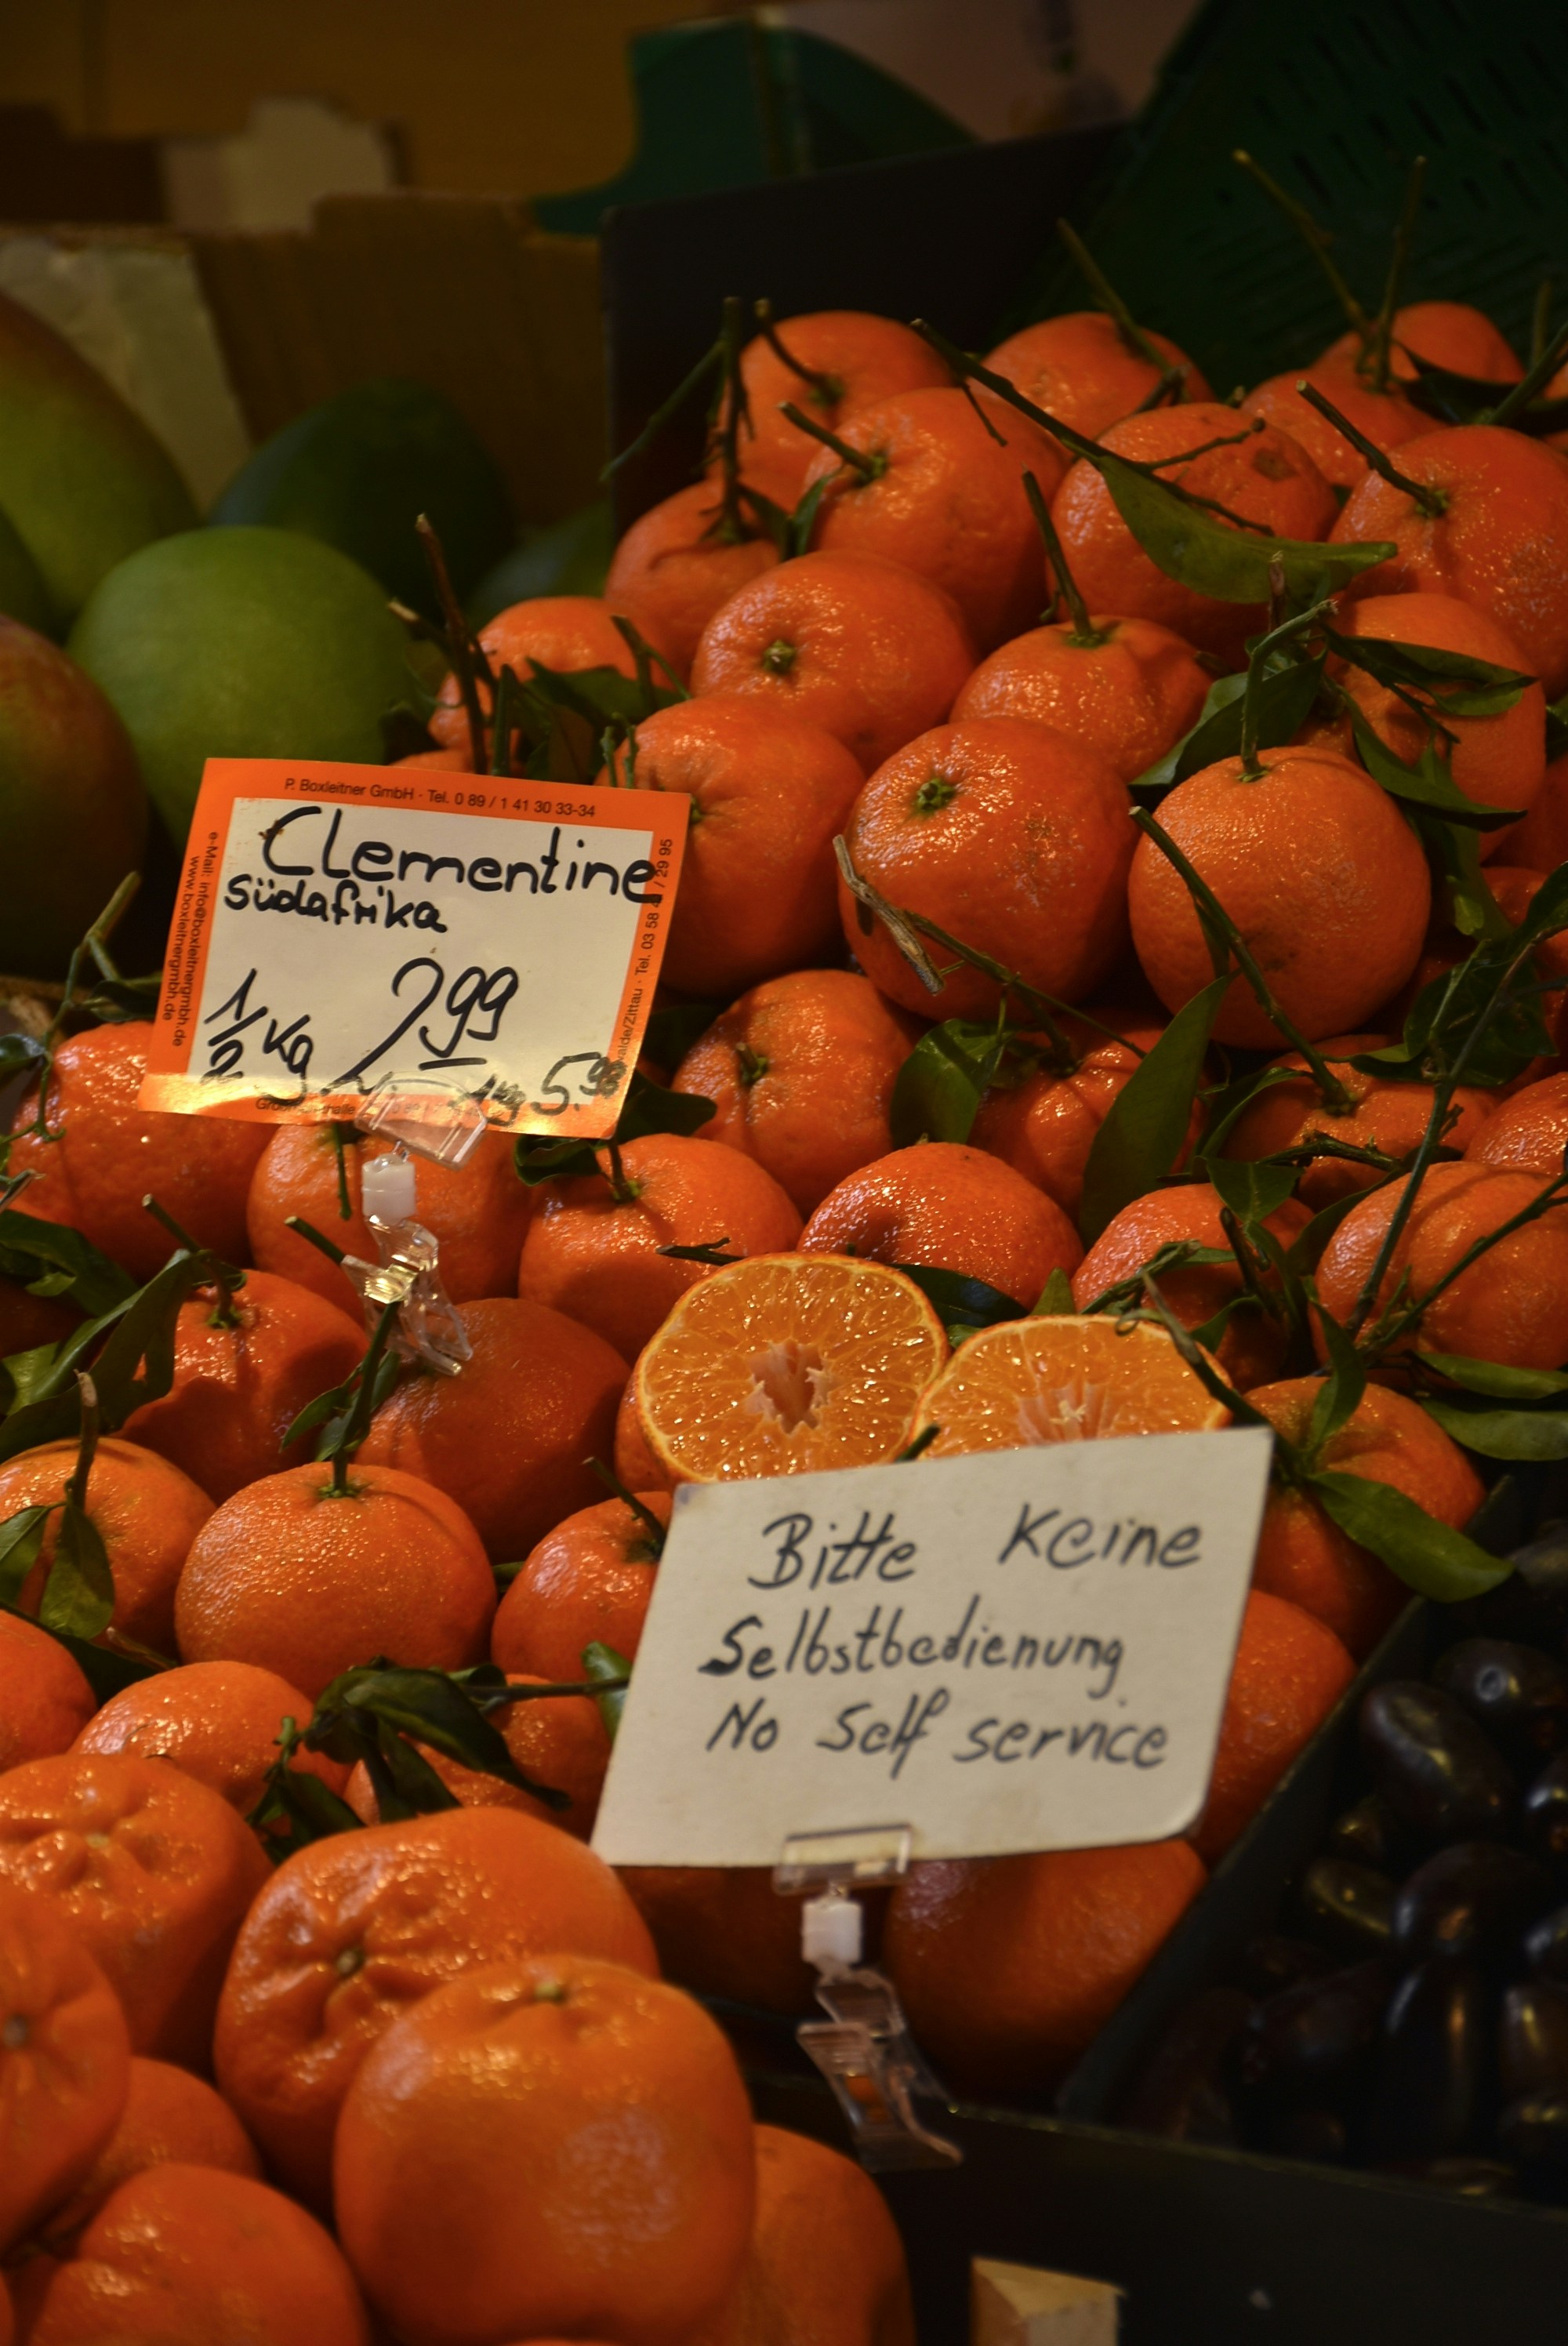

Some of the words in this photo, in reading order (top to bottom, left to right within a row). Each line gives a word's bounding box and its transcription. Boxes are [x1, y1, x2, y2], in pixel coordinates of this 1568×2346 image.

[285, 778, 296, 790] P.
[299, 779, 366, 796] Boxleitner
[370, 784, 414, 800] GmbH
[428, 789, 449, 804] Tel.
[454, 793, 464, 805] 0
[467, 794, 485, 808] 89
[500, 797, 508, 810] 1
[513, 798, 529, 812] 41
[534, 800, 551, 814] 30
[555, 801, 596, 817] 33-34
[199, 831, 219, 877] e-Mail:
[261, 806, 663, 903] Clementine
[655, 859, 670, 877] 29
[658, 838, 673, 856] 95
[162, 855, 201, 1022] www.boxleitnergmbh.de
[641, 932, 656, 950] 03
[644, 912, 660, 929] 58
[172, 881, 210, 1048] info@boxleitnergmbh.de
[633, 953, 652, 977] Tel.
[747, 1510, 918, 1590] Bitte
[698, 1592, 1125, 1700] Selbstbedienung
[706, 1697, 780, 1753] No
